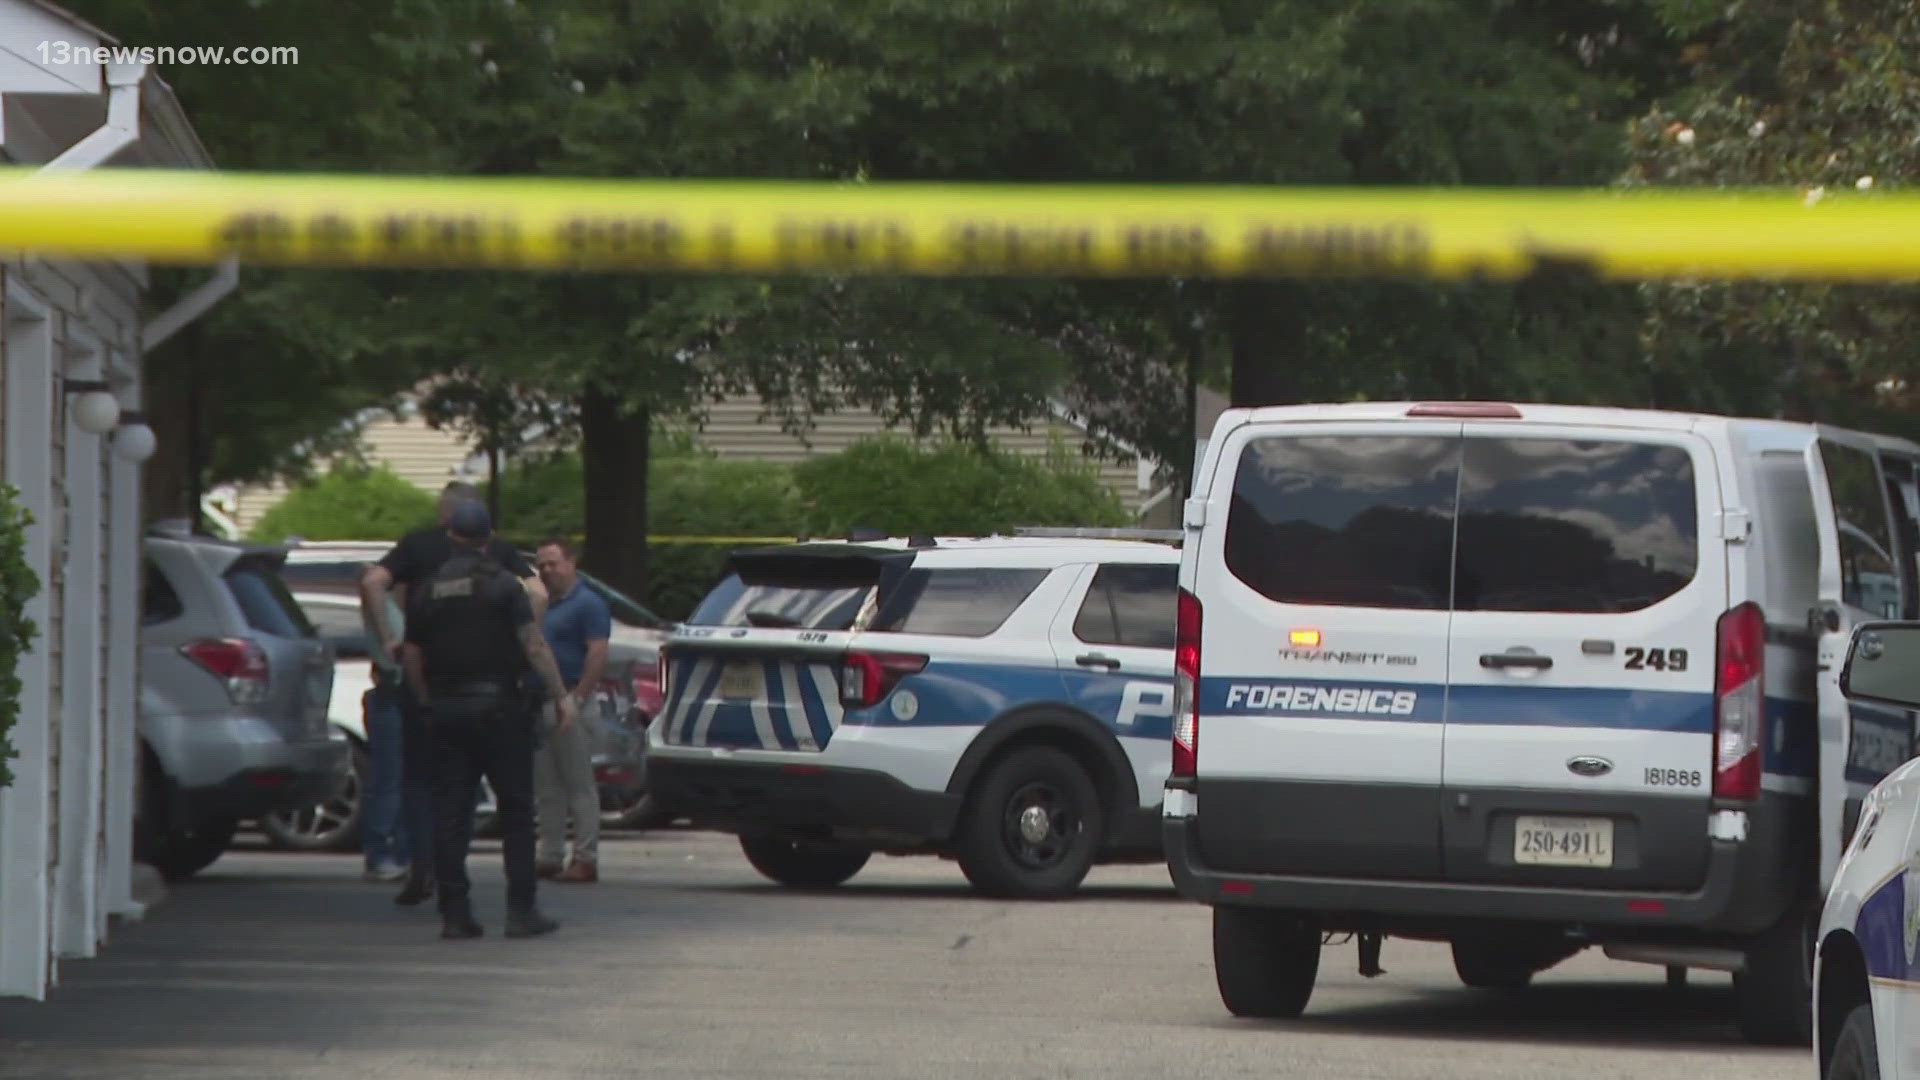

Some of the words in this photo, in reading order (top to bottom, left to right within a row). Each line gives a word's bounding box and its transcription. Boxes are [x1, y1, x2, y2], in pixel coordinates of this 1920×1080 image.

[1624, 647, 1689, 672] 249
[1225, 684, 1417, 715] FORENSICS
[1644, 767, 1701, 787] 181888
